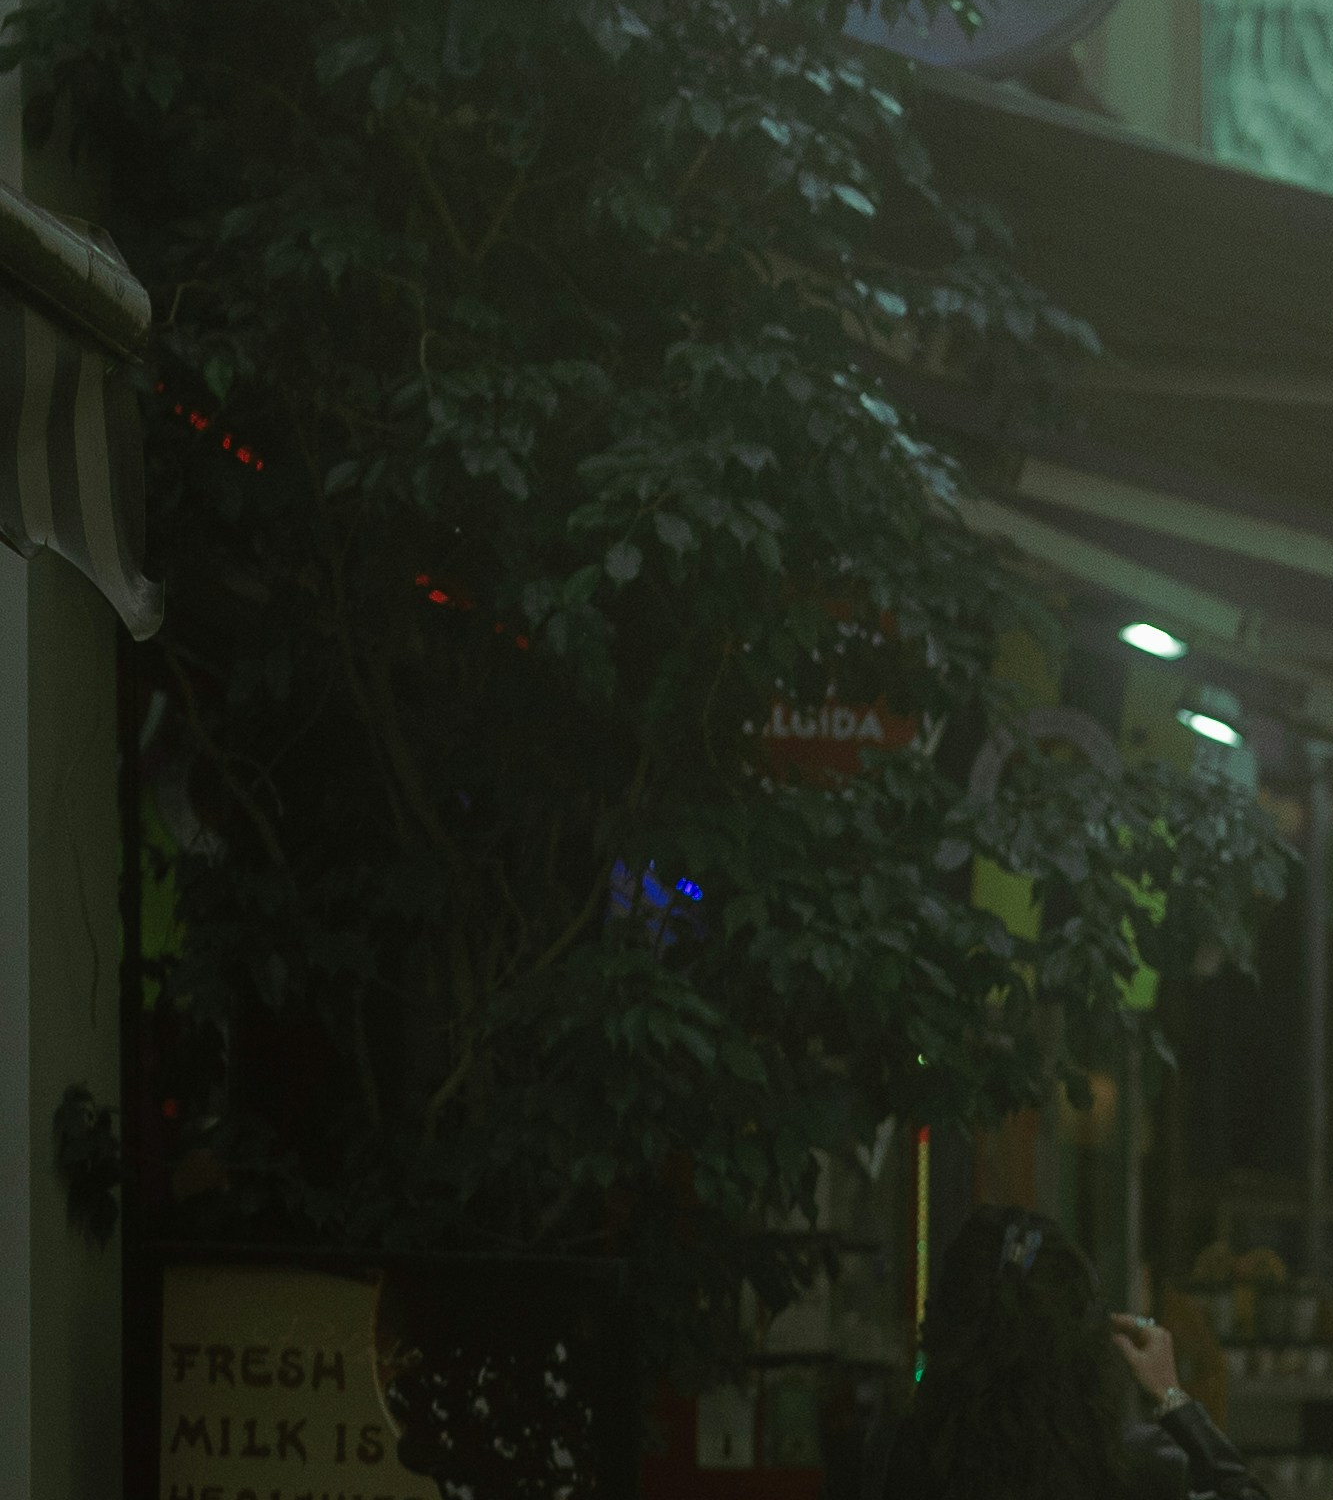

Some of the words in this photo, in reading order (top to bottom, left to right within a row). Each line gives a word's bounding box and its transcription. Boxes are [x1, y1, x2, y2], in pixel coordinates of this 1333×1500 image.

[169, 1342, 346, 1391] FRESH
[170, 1414, 309, 1469] MILK
[335, 1421, 386, 1465] IS
